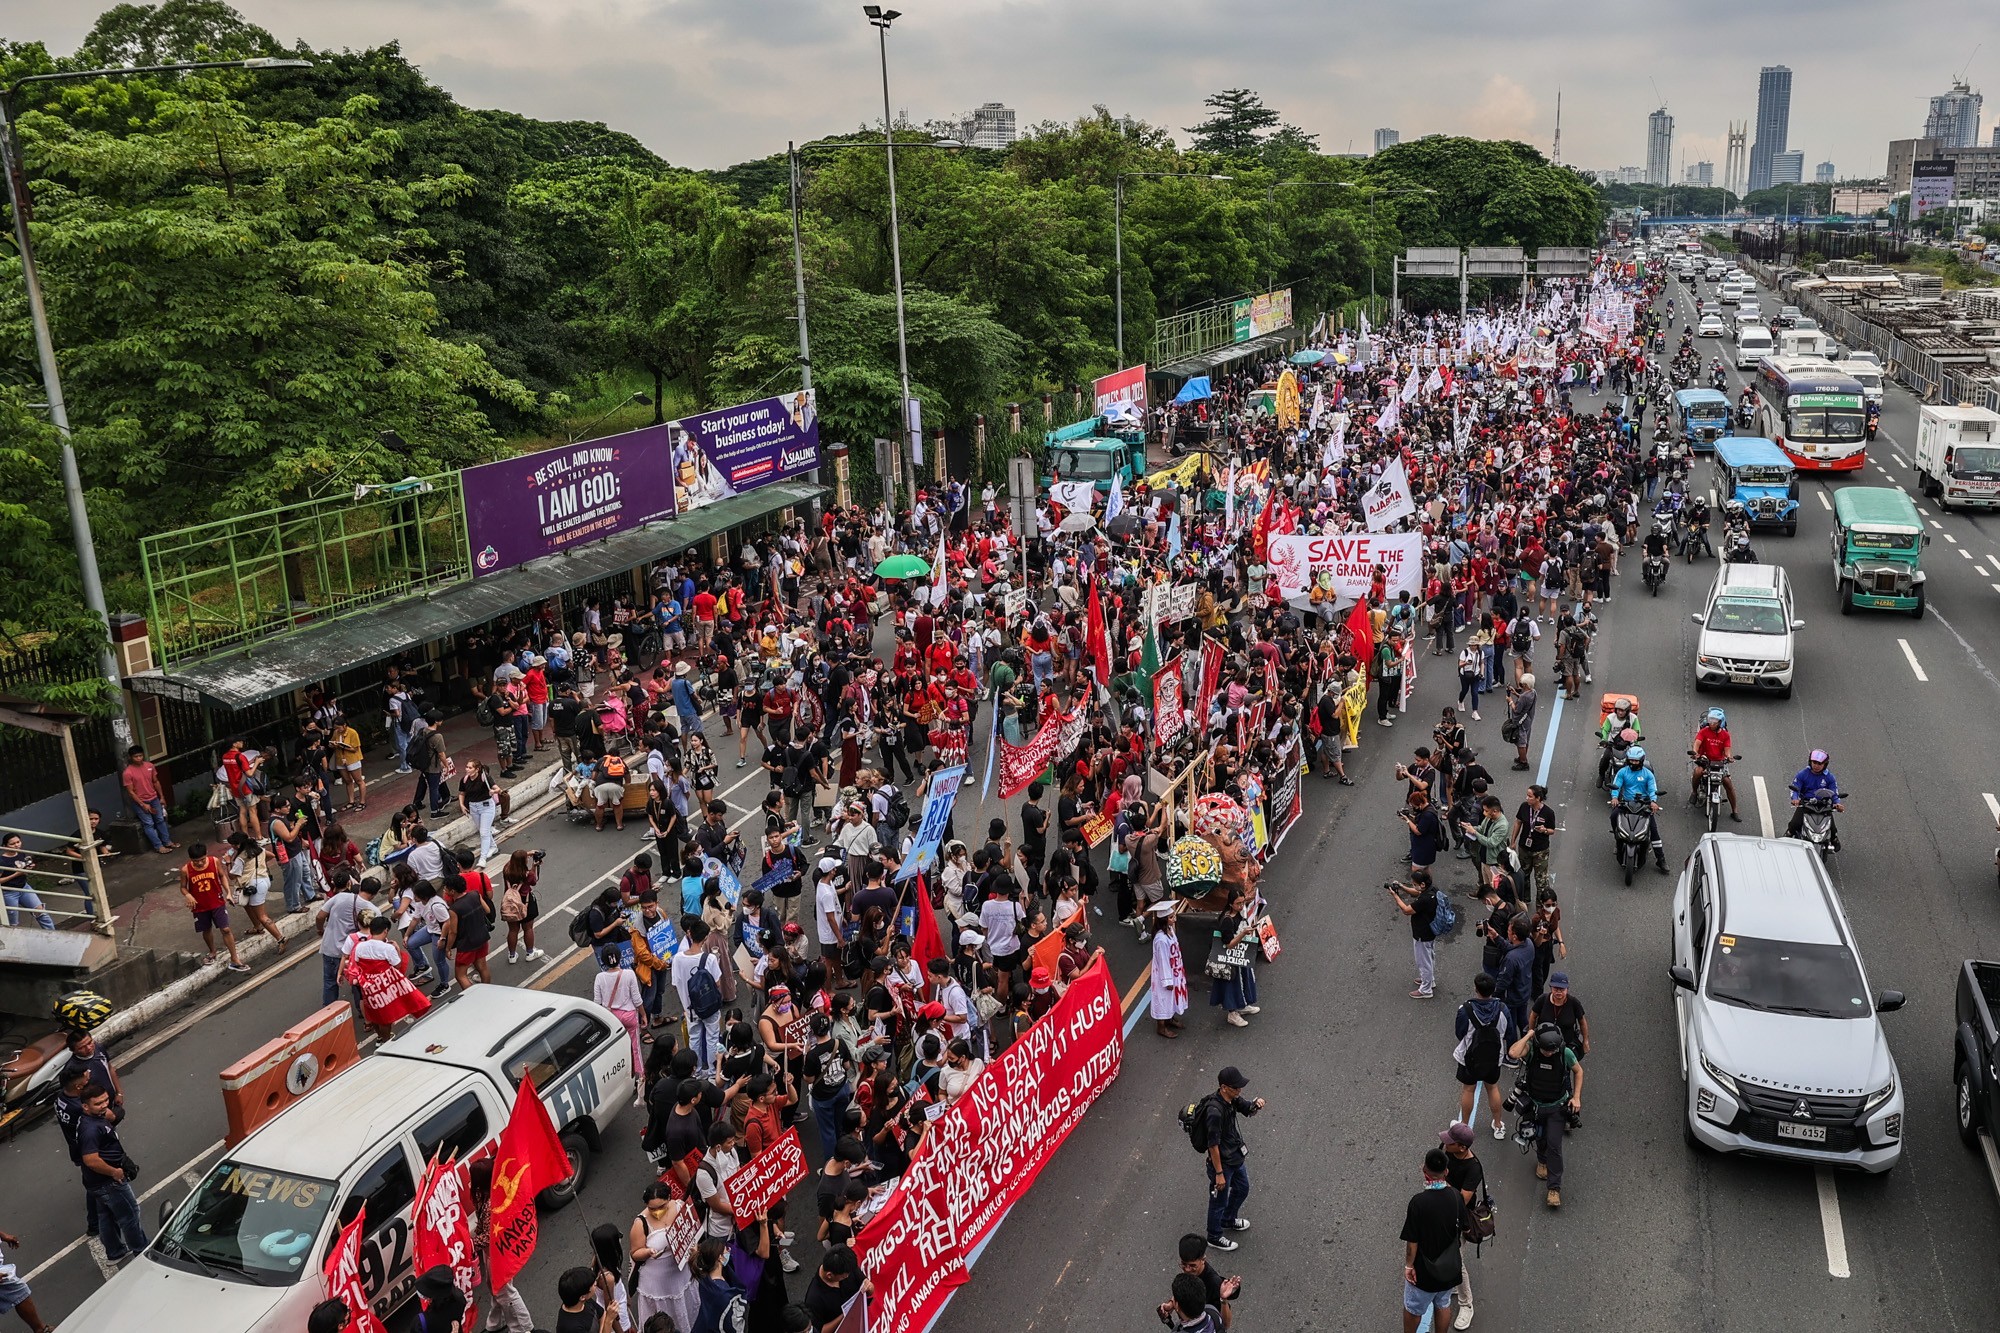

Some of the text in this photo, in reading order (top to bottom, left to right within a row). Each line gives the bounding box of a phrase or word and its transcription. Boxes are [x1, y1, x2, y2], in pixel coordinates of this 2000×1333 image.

[701, 408, 770, 434] Start your own
[715, 418, 785, 448] business today!
[534, 448, 613, 486] BE STILL, AND KNOW
[780, 446, 816, 466] ASIALINK
[568, 468, 586, 481] THAT
[538, 472, 620, 524] I AM GOD;
[544, 523, 557, 536] WILL
[556, 522, 563, 532] BE
[562, 516, 581, 531] EXALTED
[582, 511, 596, 524] AMONG
[596, 507, 604, 518] THE
[556, 534, 567, 545] WILL
[566, 532, 573, 540] BE
[572, 525, 590, 539] EXALTED
[594, 520, 602, 530] THE
[1308, 539, 1404, 563] SAVE THE
[1336, 564, 1399, 577] GRANAY!
[198, 880, 211, 892] 23
[1226, 954, 1250, 967] JUSTICE
[602, 1058, 626, 1084] 11-082
[972, 1015, 1054, 1120] NG BAYAN
[550, 1063, 600, 1131] FM
[978, 1061, 1045, 1145] DANGAL
[1052, 1027, 1067, 1066] AT
[1780, 1124, 1826, 1140] NET 6152
[729, 1134, 794, 1194] FREE TUITION
[1034, 1144, 1044, 1162] OF
[220, 1168, 322, 1208] NEWS
[743, 1160, 800, 1218] COLLECTION
[746, 1160, 782, 1198] HINDI
